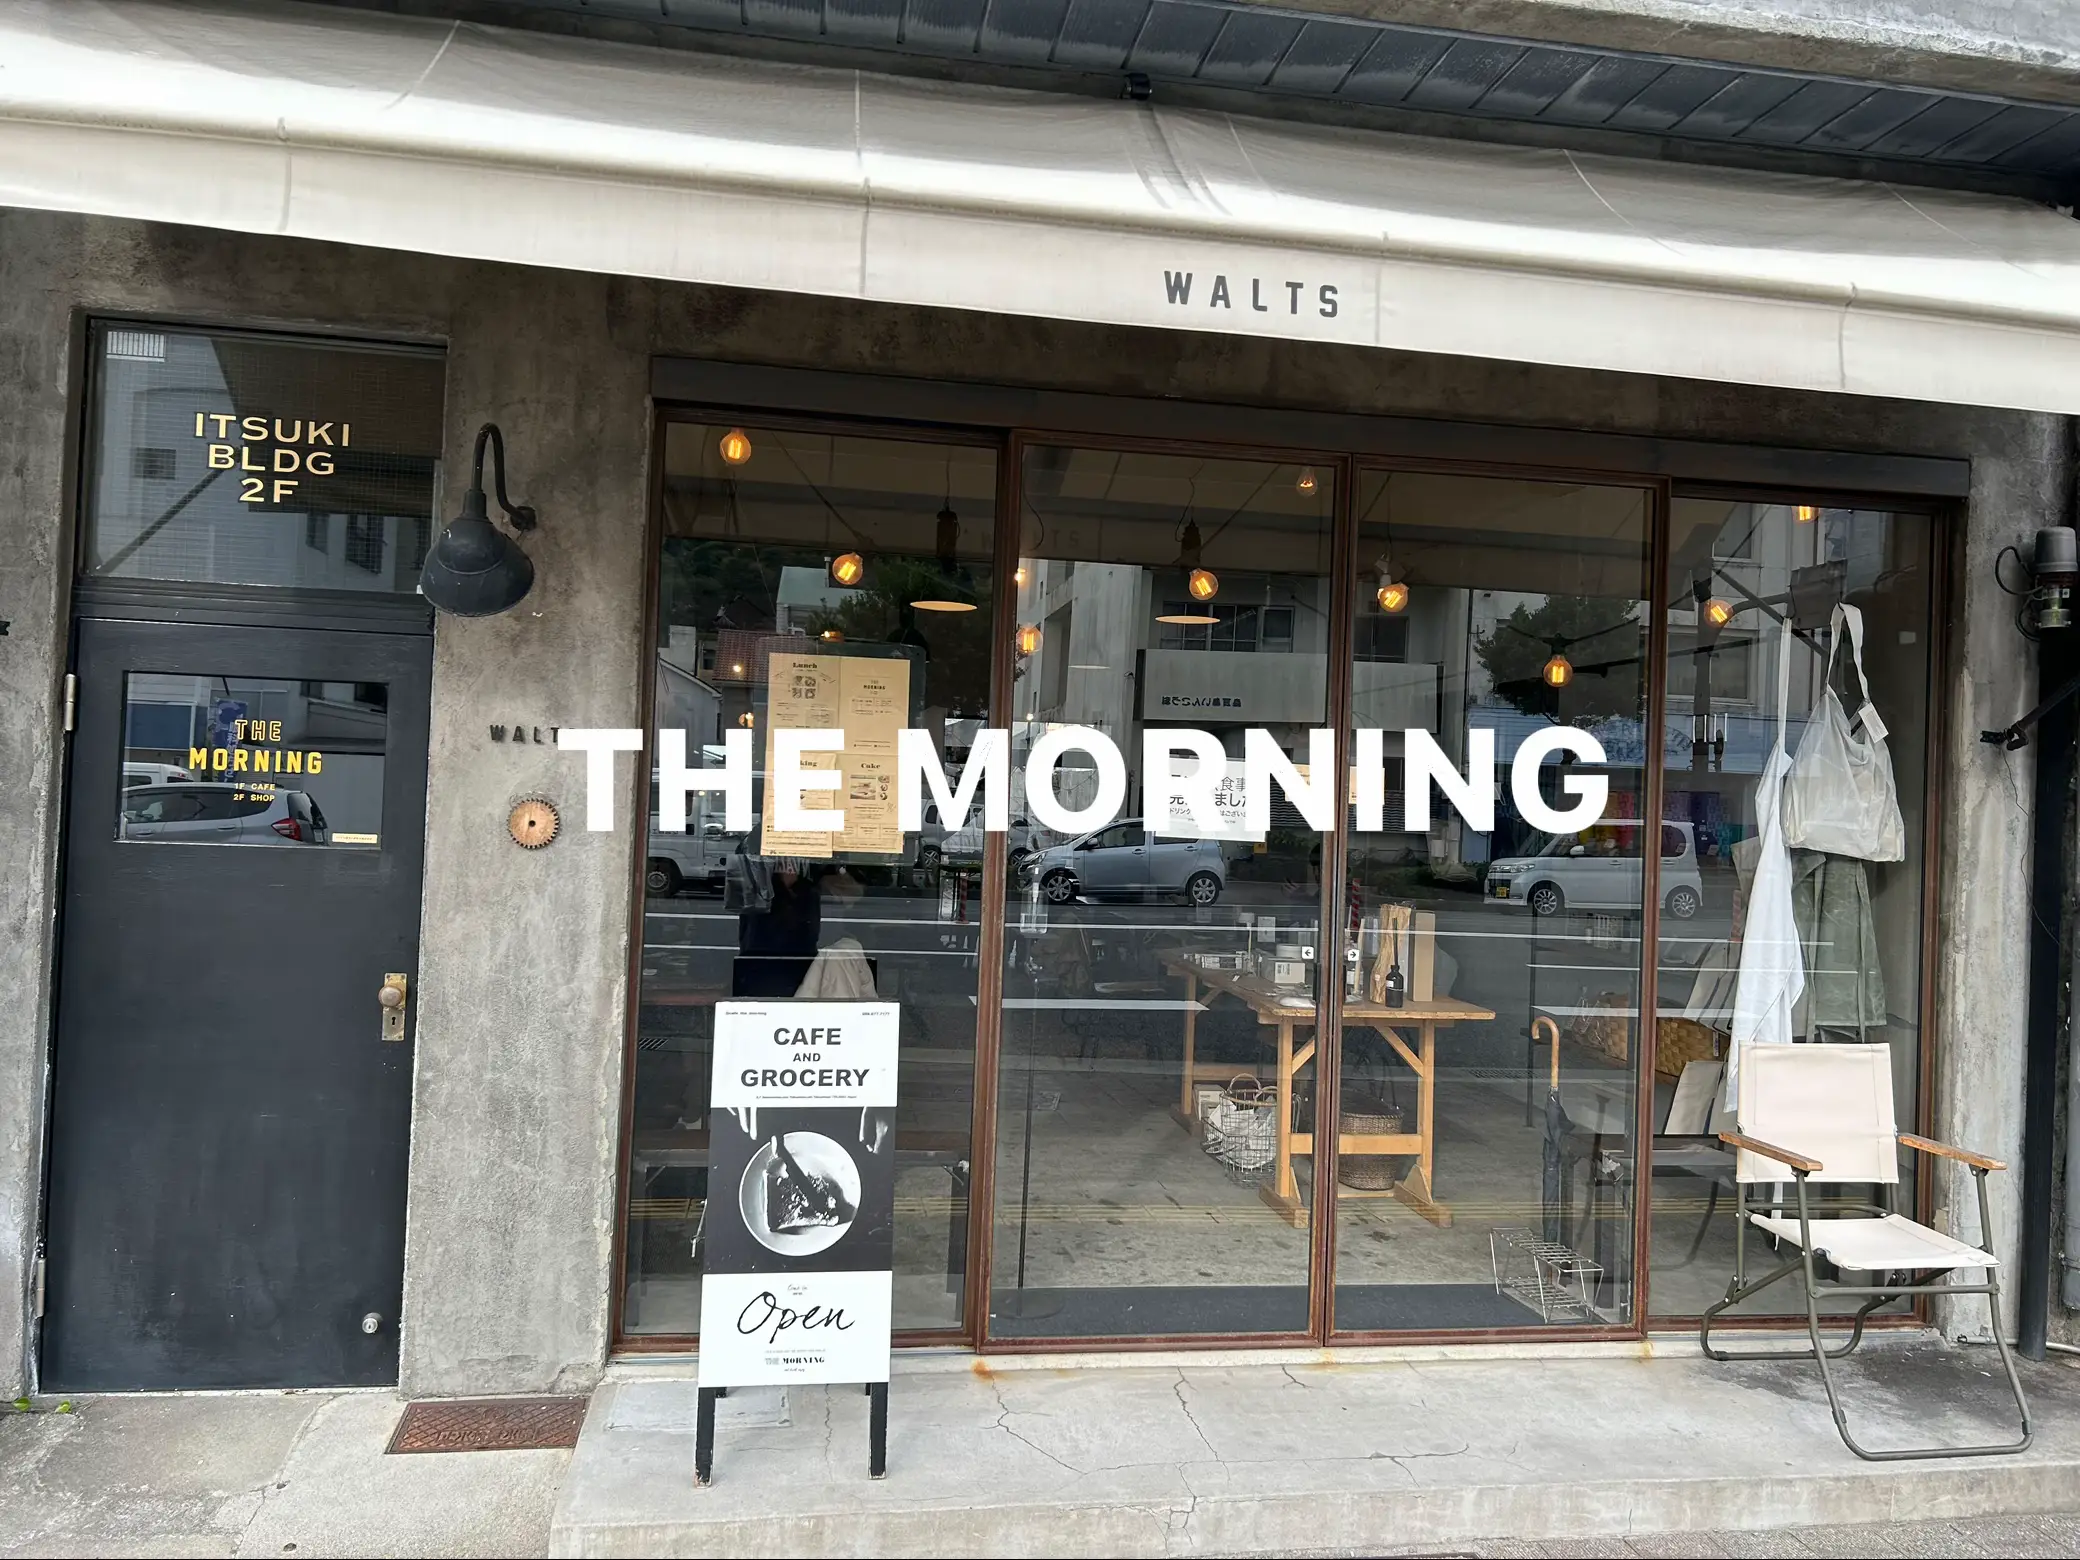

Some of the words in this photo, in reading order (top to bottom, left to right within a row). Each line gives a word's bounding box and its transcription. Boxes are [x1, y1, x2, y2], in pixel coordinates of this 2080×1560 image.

[1164, 270, 1338, 318] WALTS
[195, 412, 350, 447] ITSUKI
[208, 444, 335, 476] BLDG
[239, 477, 299, 503] 2F
[234, 719, 282, 742] THE
[188, 747, 323, 775] MORNING
[233, 793, 245, 801] 2F
[250, 794, 275, 802] SHOP
[234, 782, 246, 790] 1F
[250, 783, 276, 791] CAFE
[773, 1027, 842, 1046] CAFE
[792, 1052, 822, 1062] AND
[740, 1068, 870, 1087] GROCERY
[737, 1291, 855, 1344] Open
[782, 1356, 825, 1364] MORNING
